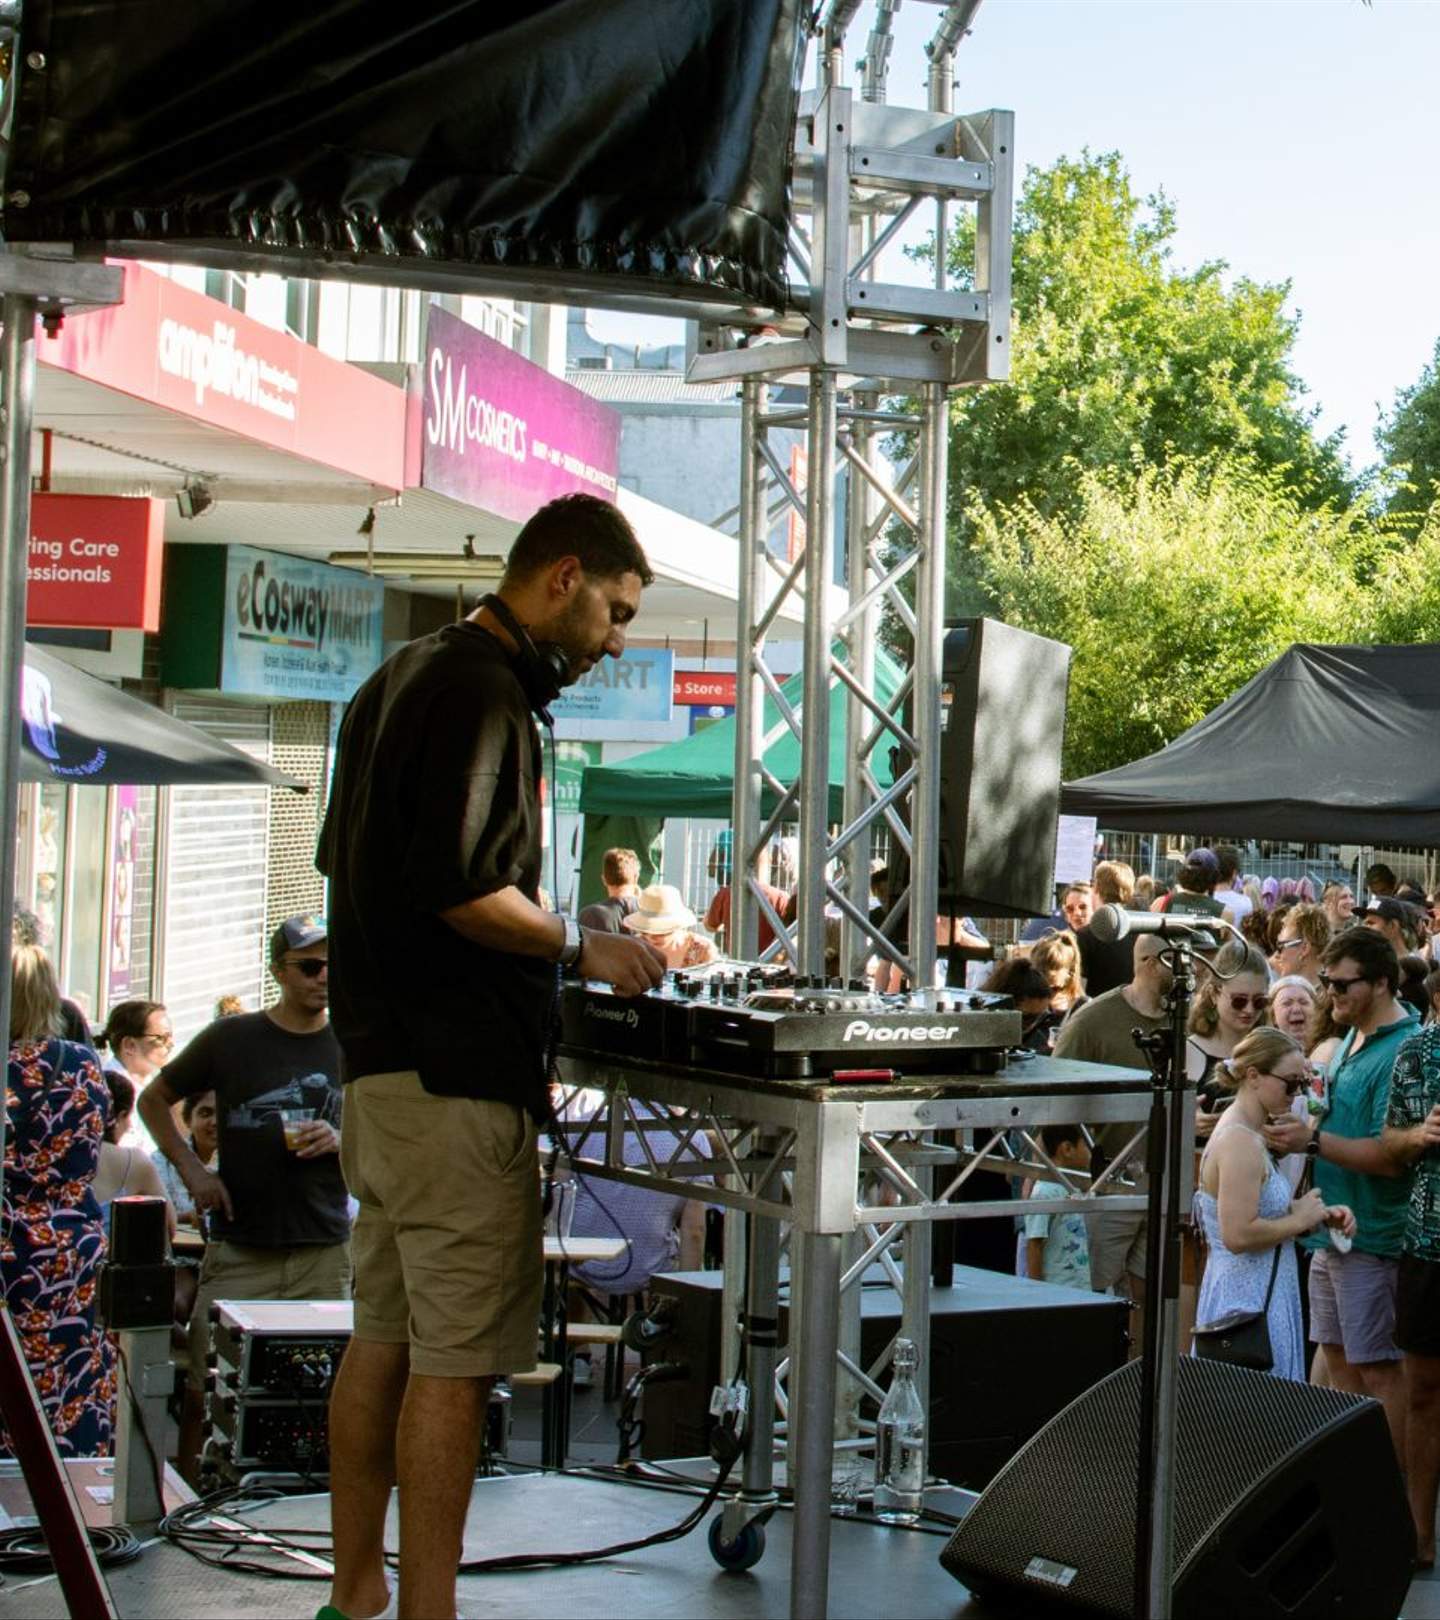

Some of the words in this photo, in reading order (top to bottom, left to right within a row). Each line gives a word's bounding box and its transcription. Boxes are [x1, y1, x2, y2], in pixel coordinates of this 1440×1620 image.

[428, 347, 466, 455] SM
[69, 538, 119, 557] Care
[581, 660, 656, 690] ART
[685, 682, 723, 695] Store
[584, 1001, 626, 1021] Pioneer
[843, 1020, 960, 1042] Pioneer
